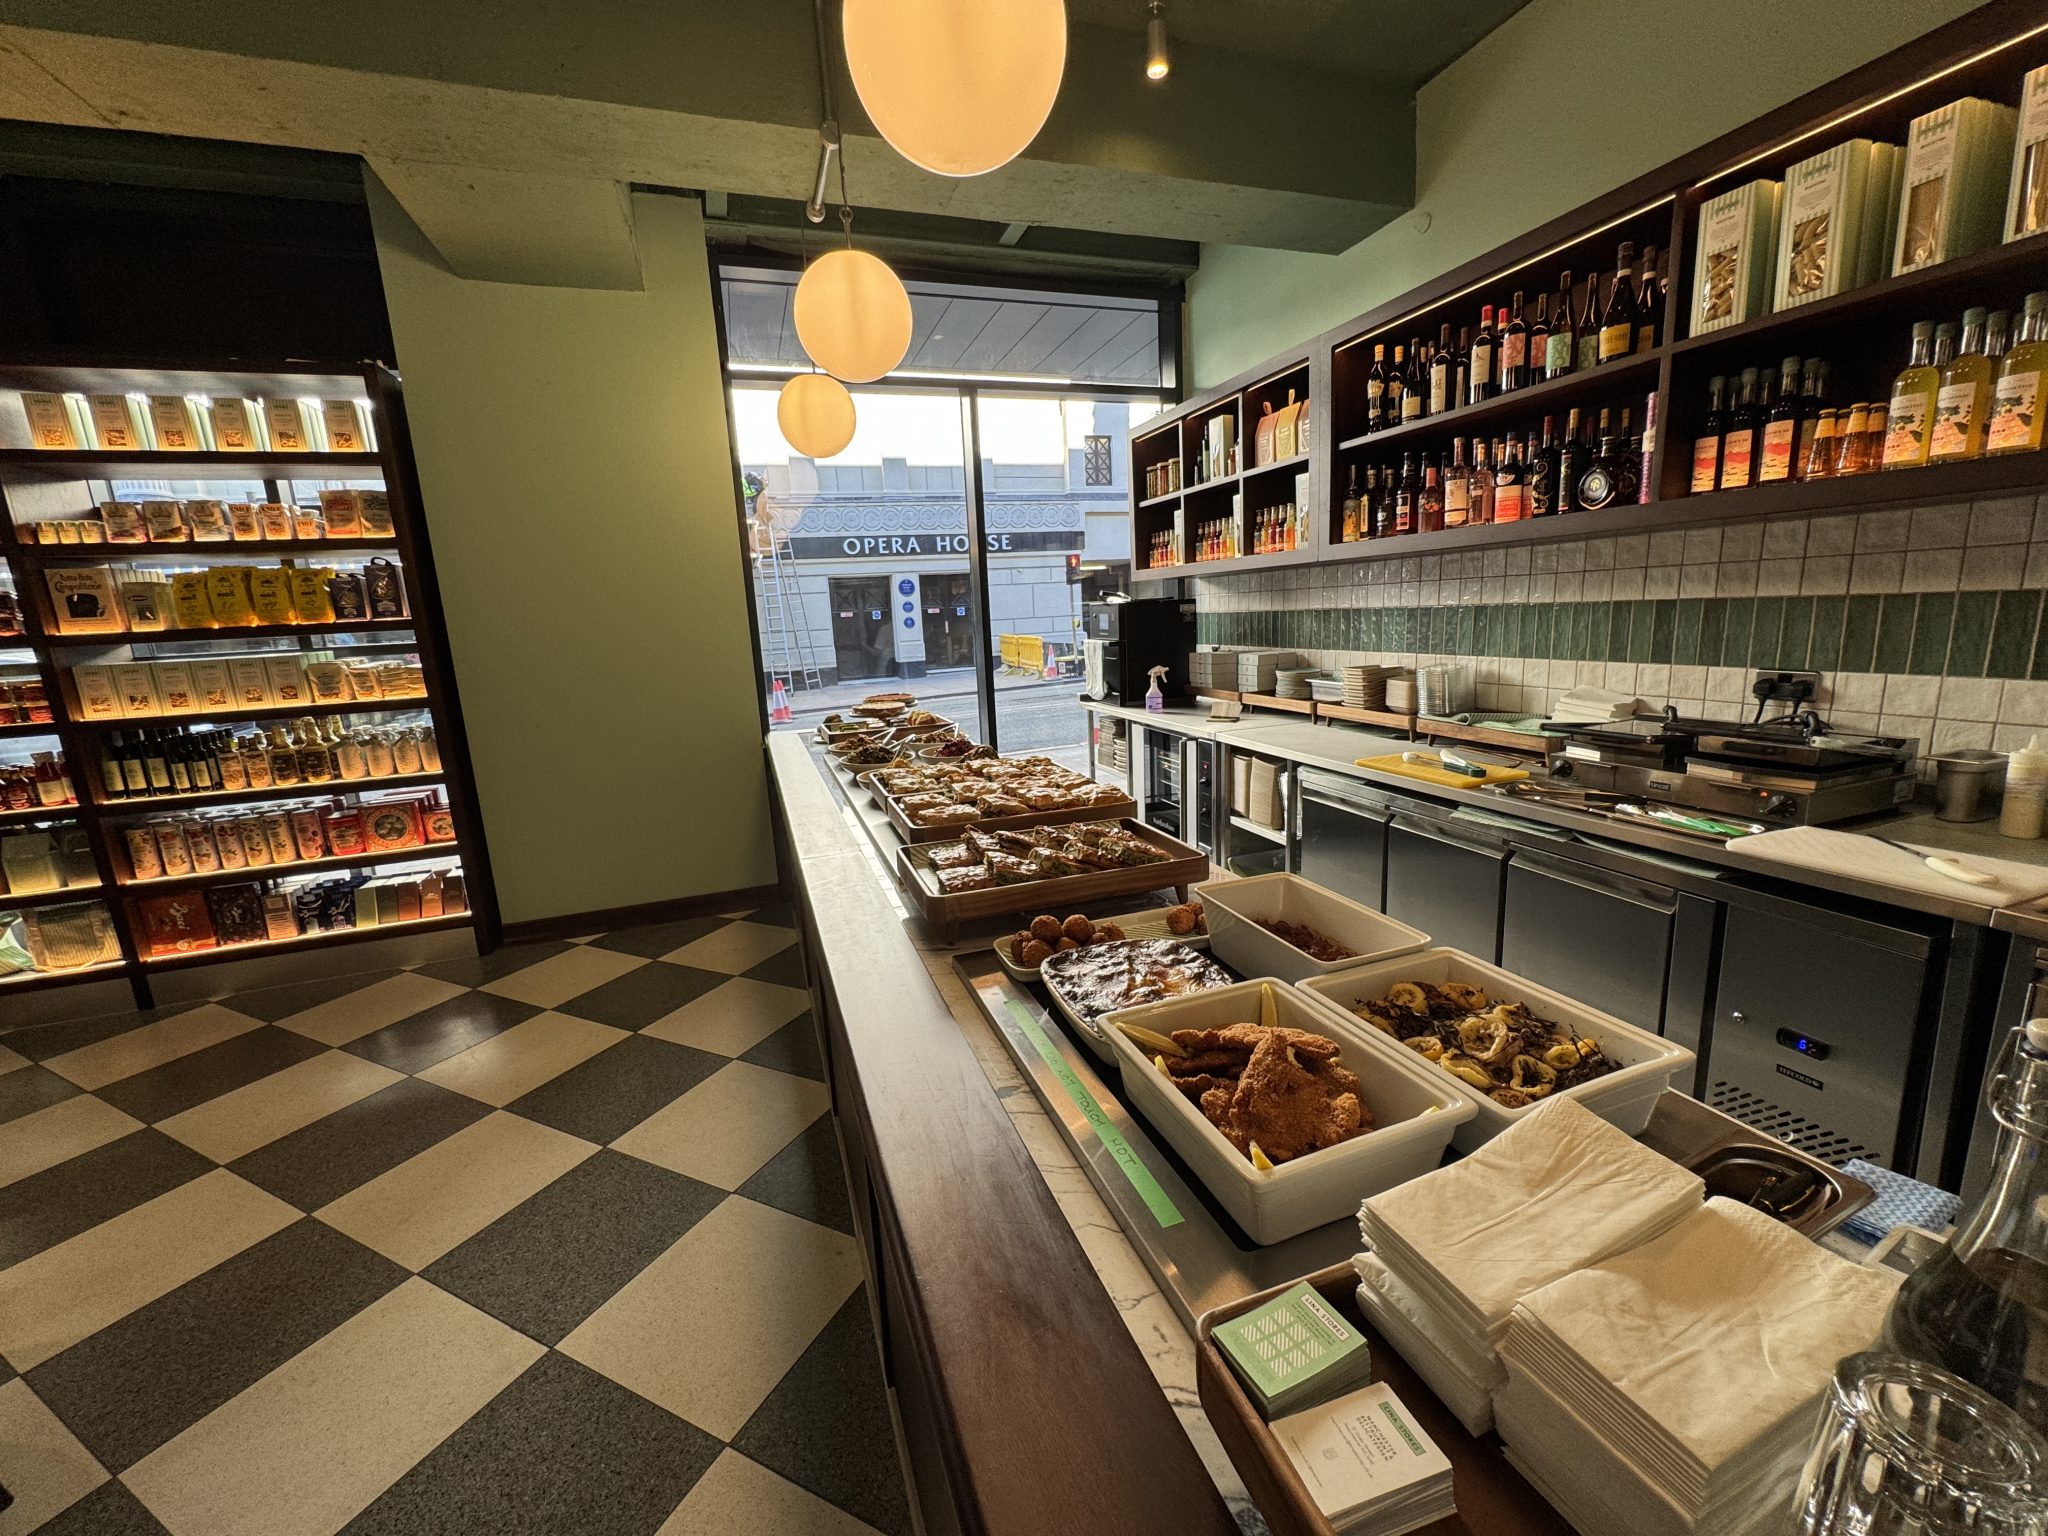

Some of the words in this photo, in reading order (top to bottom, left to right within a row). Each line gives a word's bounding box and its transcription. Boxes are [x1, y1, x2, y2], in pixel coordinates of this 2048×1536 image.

[843, 536, 921, 555] OPERA
[936, 534, 1013, 553] HOSE
[1046, 1051, 1058, 1065] DO
[1058, 1069, 1076, 1086] NOT
[1076, 1092, 1106, 1127] TOUCH
[1109, 1138, 1137, 1165] HOT
[1305, 1297, 1320, 1313] LINA
[1321, 1313, 1346, 1337] STORES
[1356, 1416, 1389, 1461] DELICATESSEN
[1360, 1415, 1391, 1454] RESTAURANT
[1366, 1415, 1397, 1456] MANCHESTER
[1384, 1406, 1398, 1423] LINA
[1398, 1424, 1421, 1451] STORES
